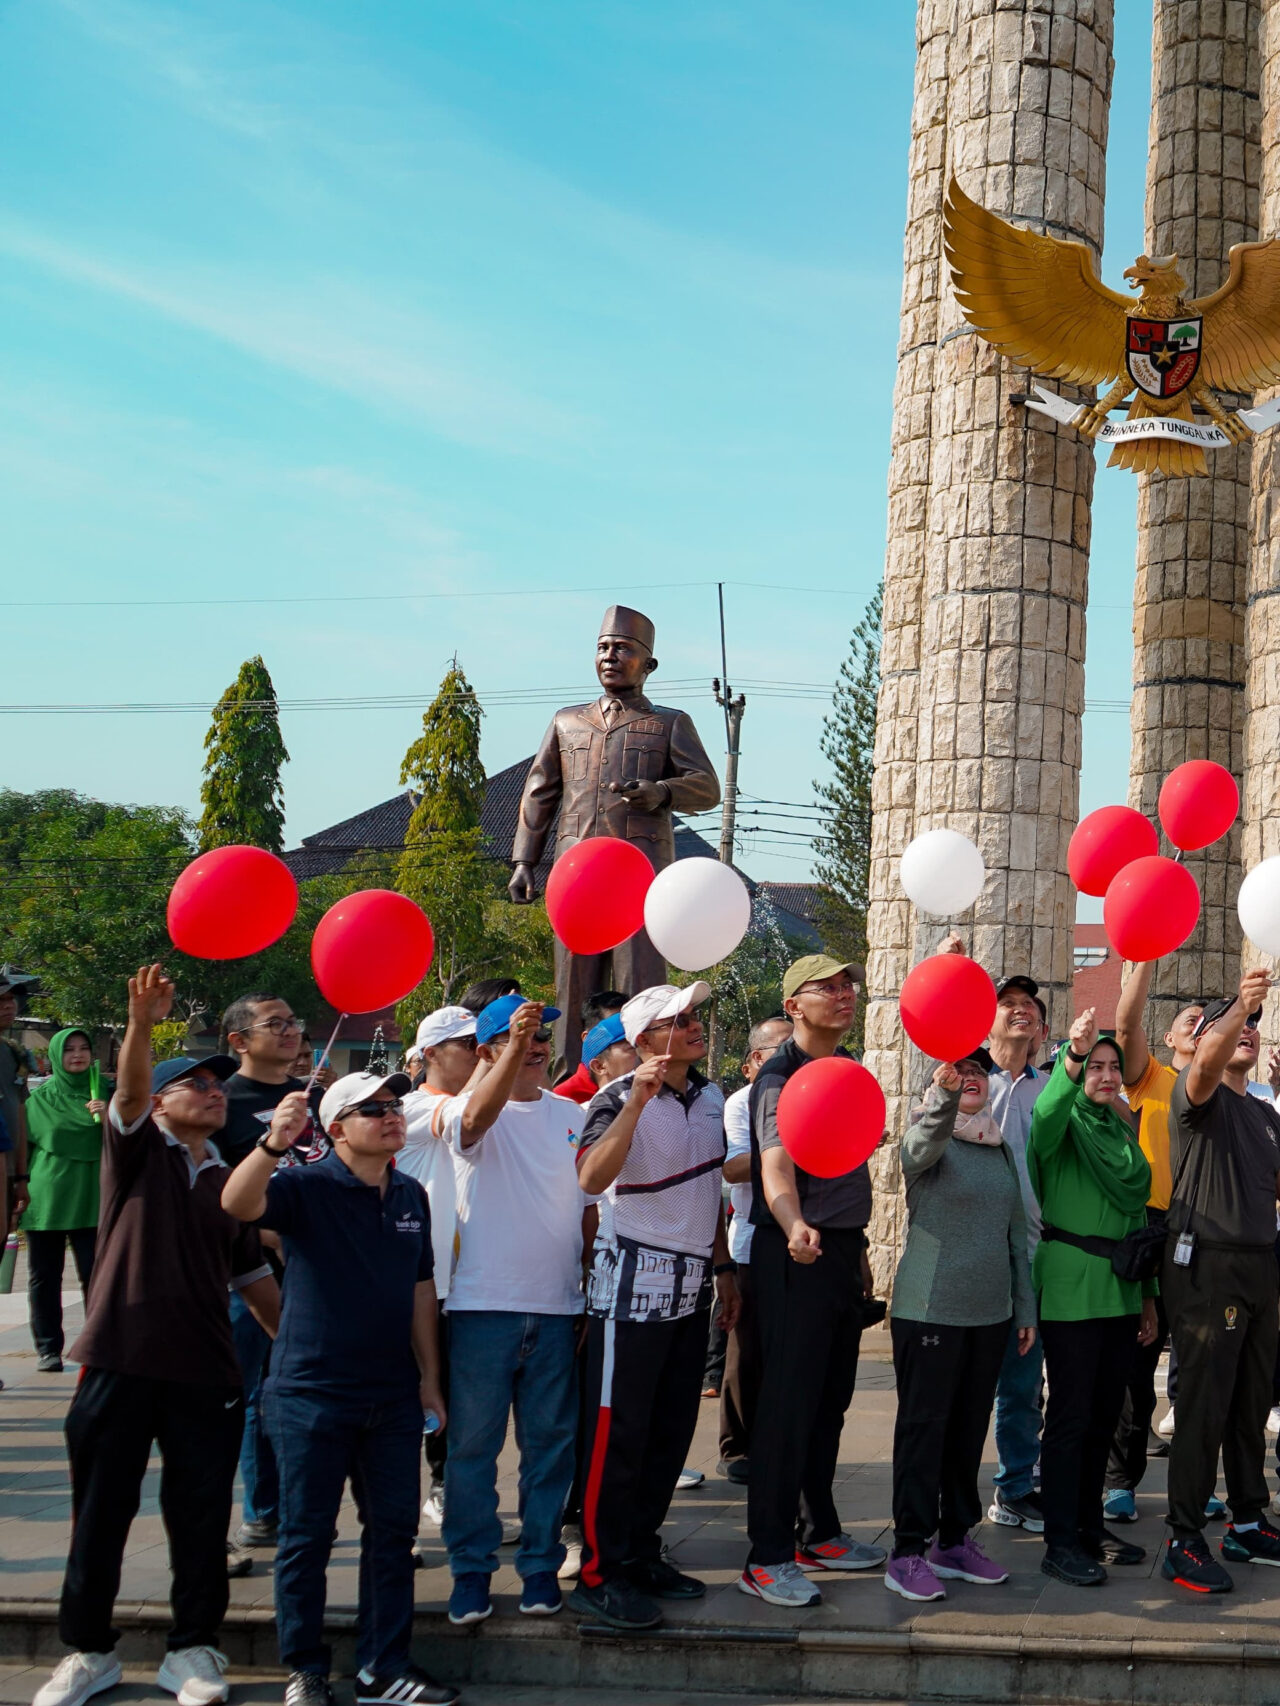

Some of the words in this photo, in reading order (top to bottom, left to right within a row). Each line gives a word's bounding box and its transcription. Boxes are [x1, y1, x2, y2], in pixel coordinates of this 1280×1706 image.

[1101, 422, 1155, 436] BHINNEKA
[1160, 422, 1205, 440] TUNGGAL
[1206, 430, 1225, 441] IKA
